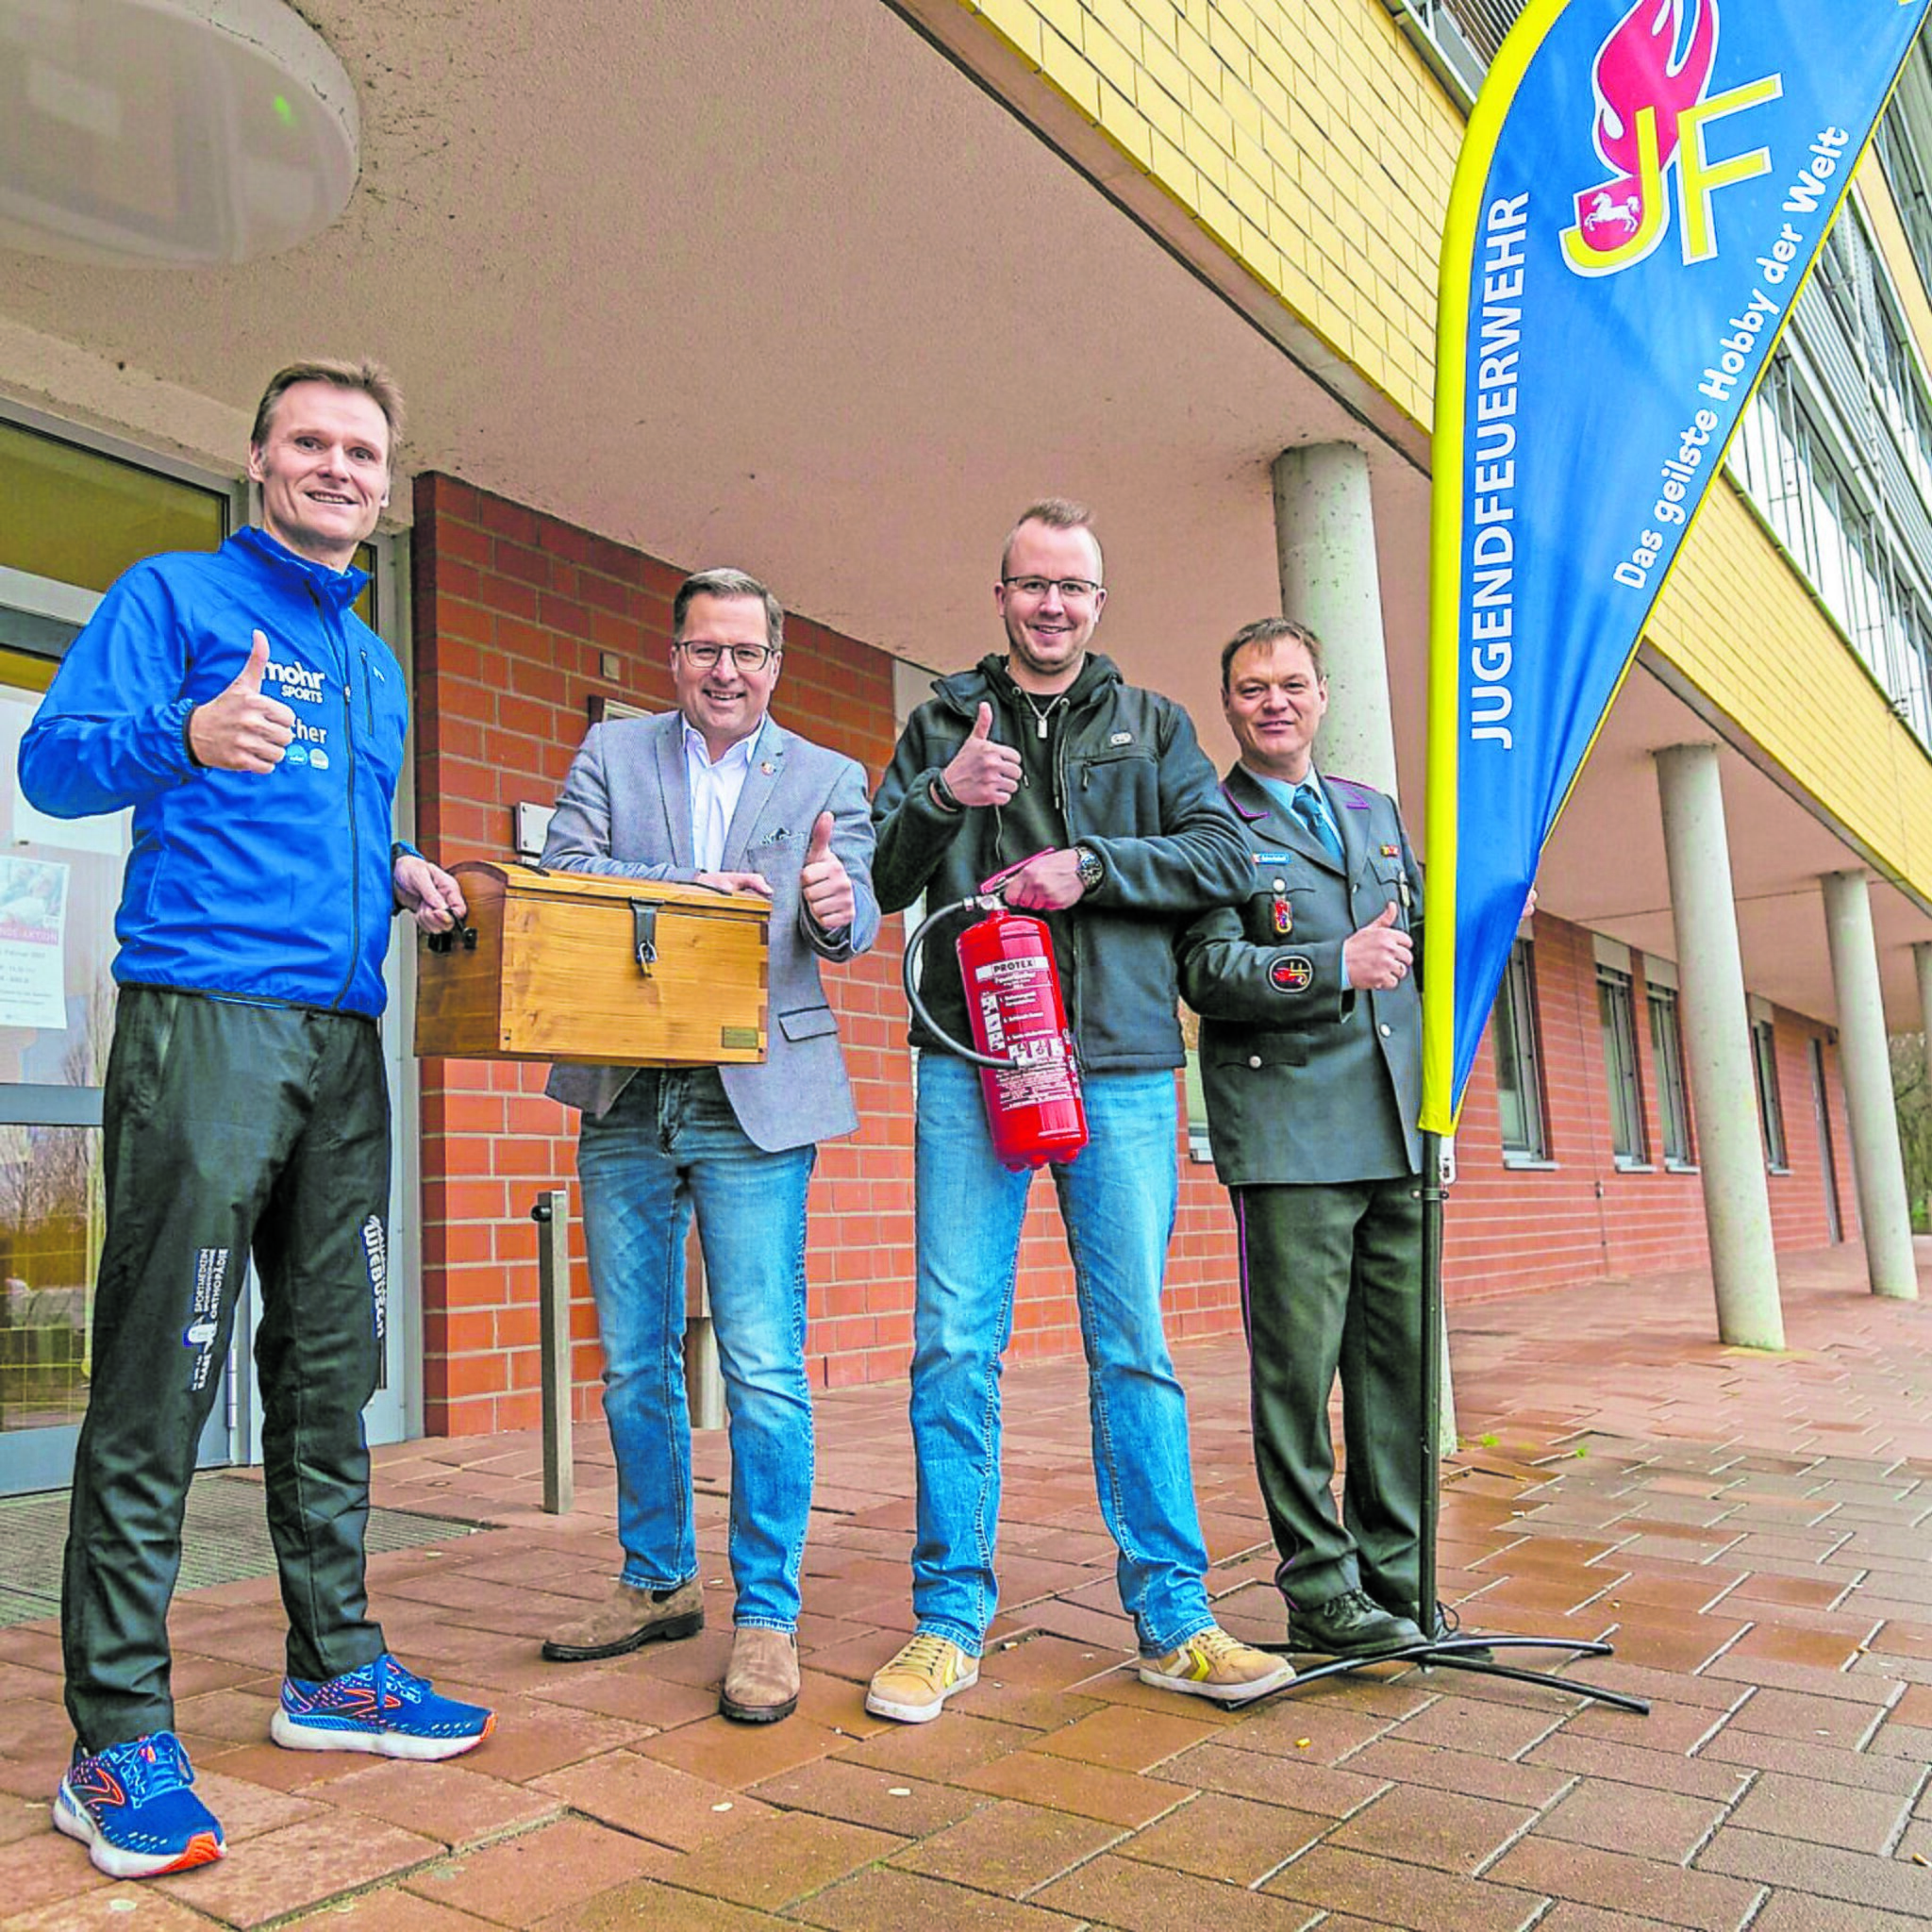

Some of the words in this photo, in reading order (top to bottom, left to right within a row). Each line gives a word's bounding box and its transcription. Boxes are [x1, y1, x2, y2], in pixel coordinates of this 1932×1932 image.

[1558, 73, 1784, 278] JF
[1612, 529, 1663, 590] Das
[1654, 409, 1718, 525] geilste
[1698, 288, 1781, 402] Hobby
[1756, 223, 1803, 285] der
[1782, 125, 1850, 213] Welt
[1471, 192, 1529, 750] JUGENDFEUERWEHR
[262, 661, 325, 690] mohr
[281, 684, 324, 704] SPORTS
[992, 959, 1034, 974] PROTEX
